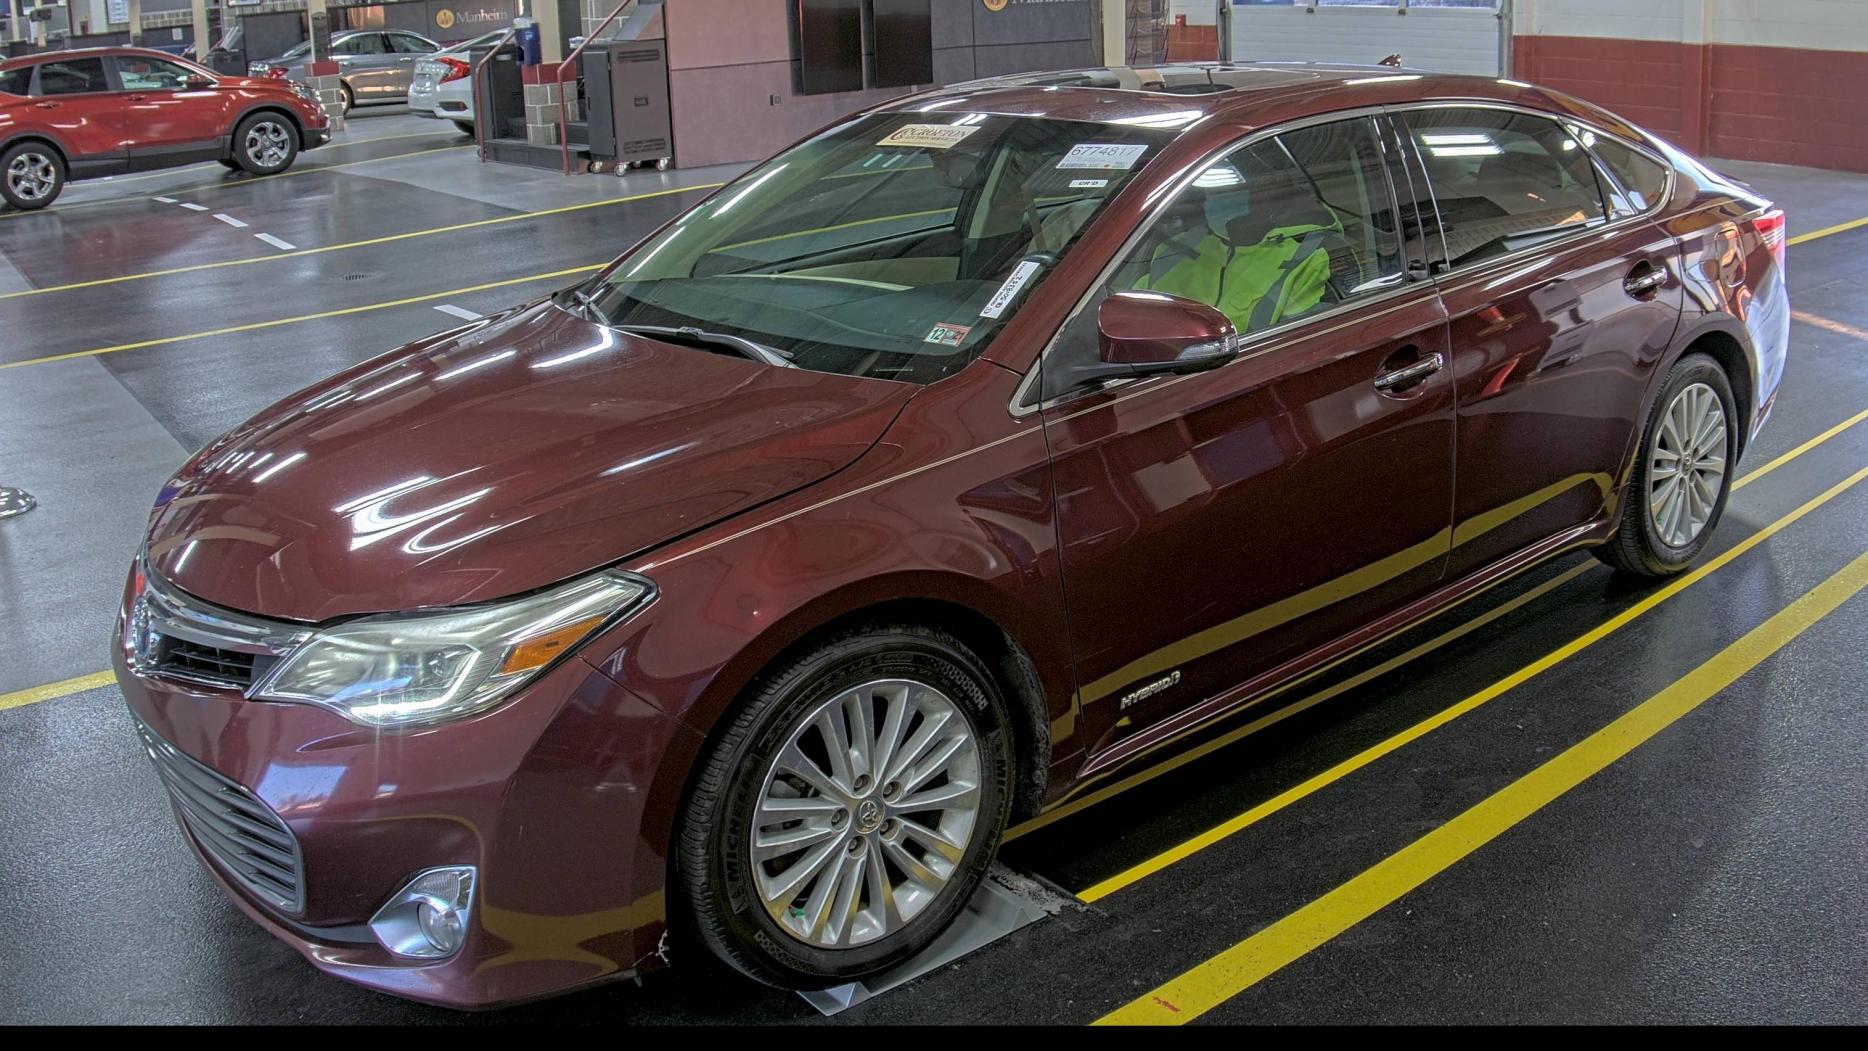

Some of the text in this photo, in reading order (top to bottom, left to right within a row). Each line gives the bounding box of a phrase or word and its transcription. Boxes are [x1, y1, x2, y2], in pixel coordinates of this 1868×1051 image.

[456, 9, 508, 23] Manheim
[1071, 146, 1138, 156] 6774817
[930, 328, 946, 340] 12
[1120, 677, 1171, 709] HYBRID
